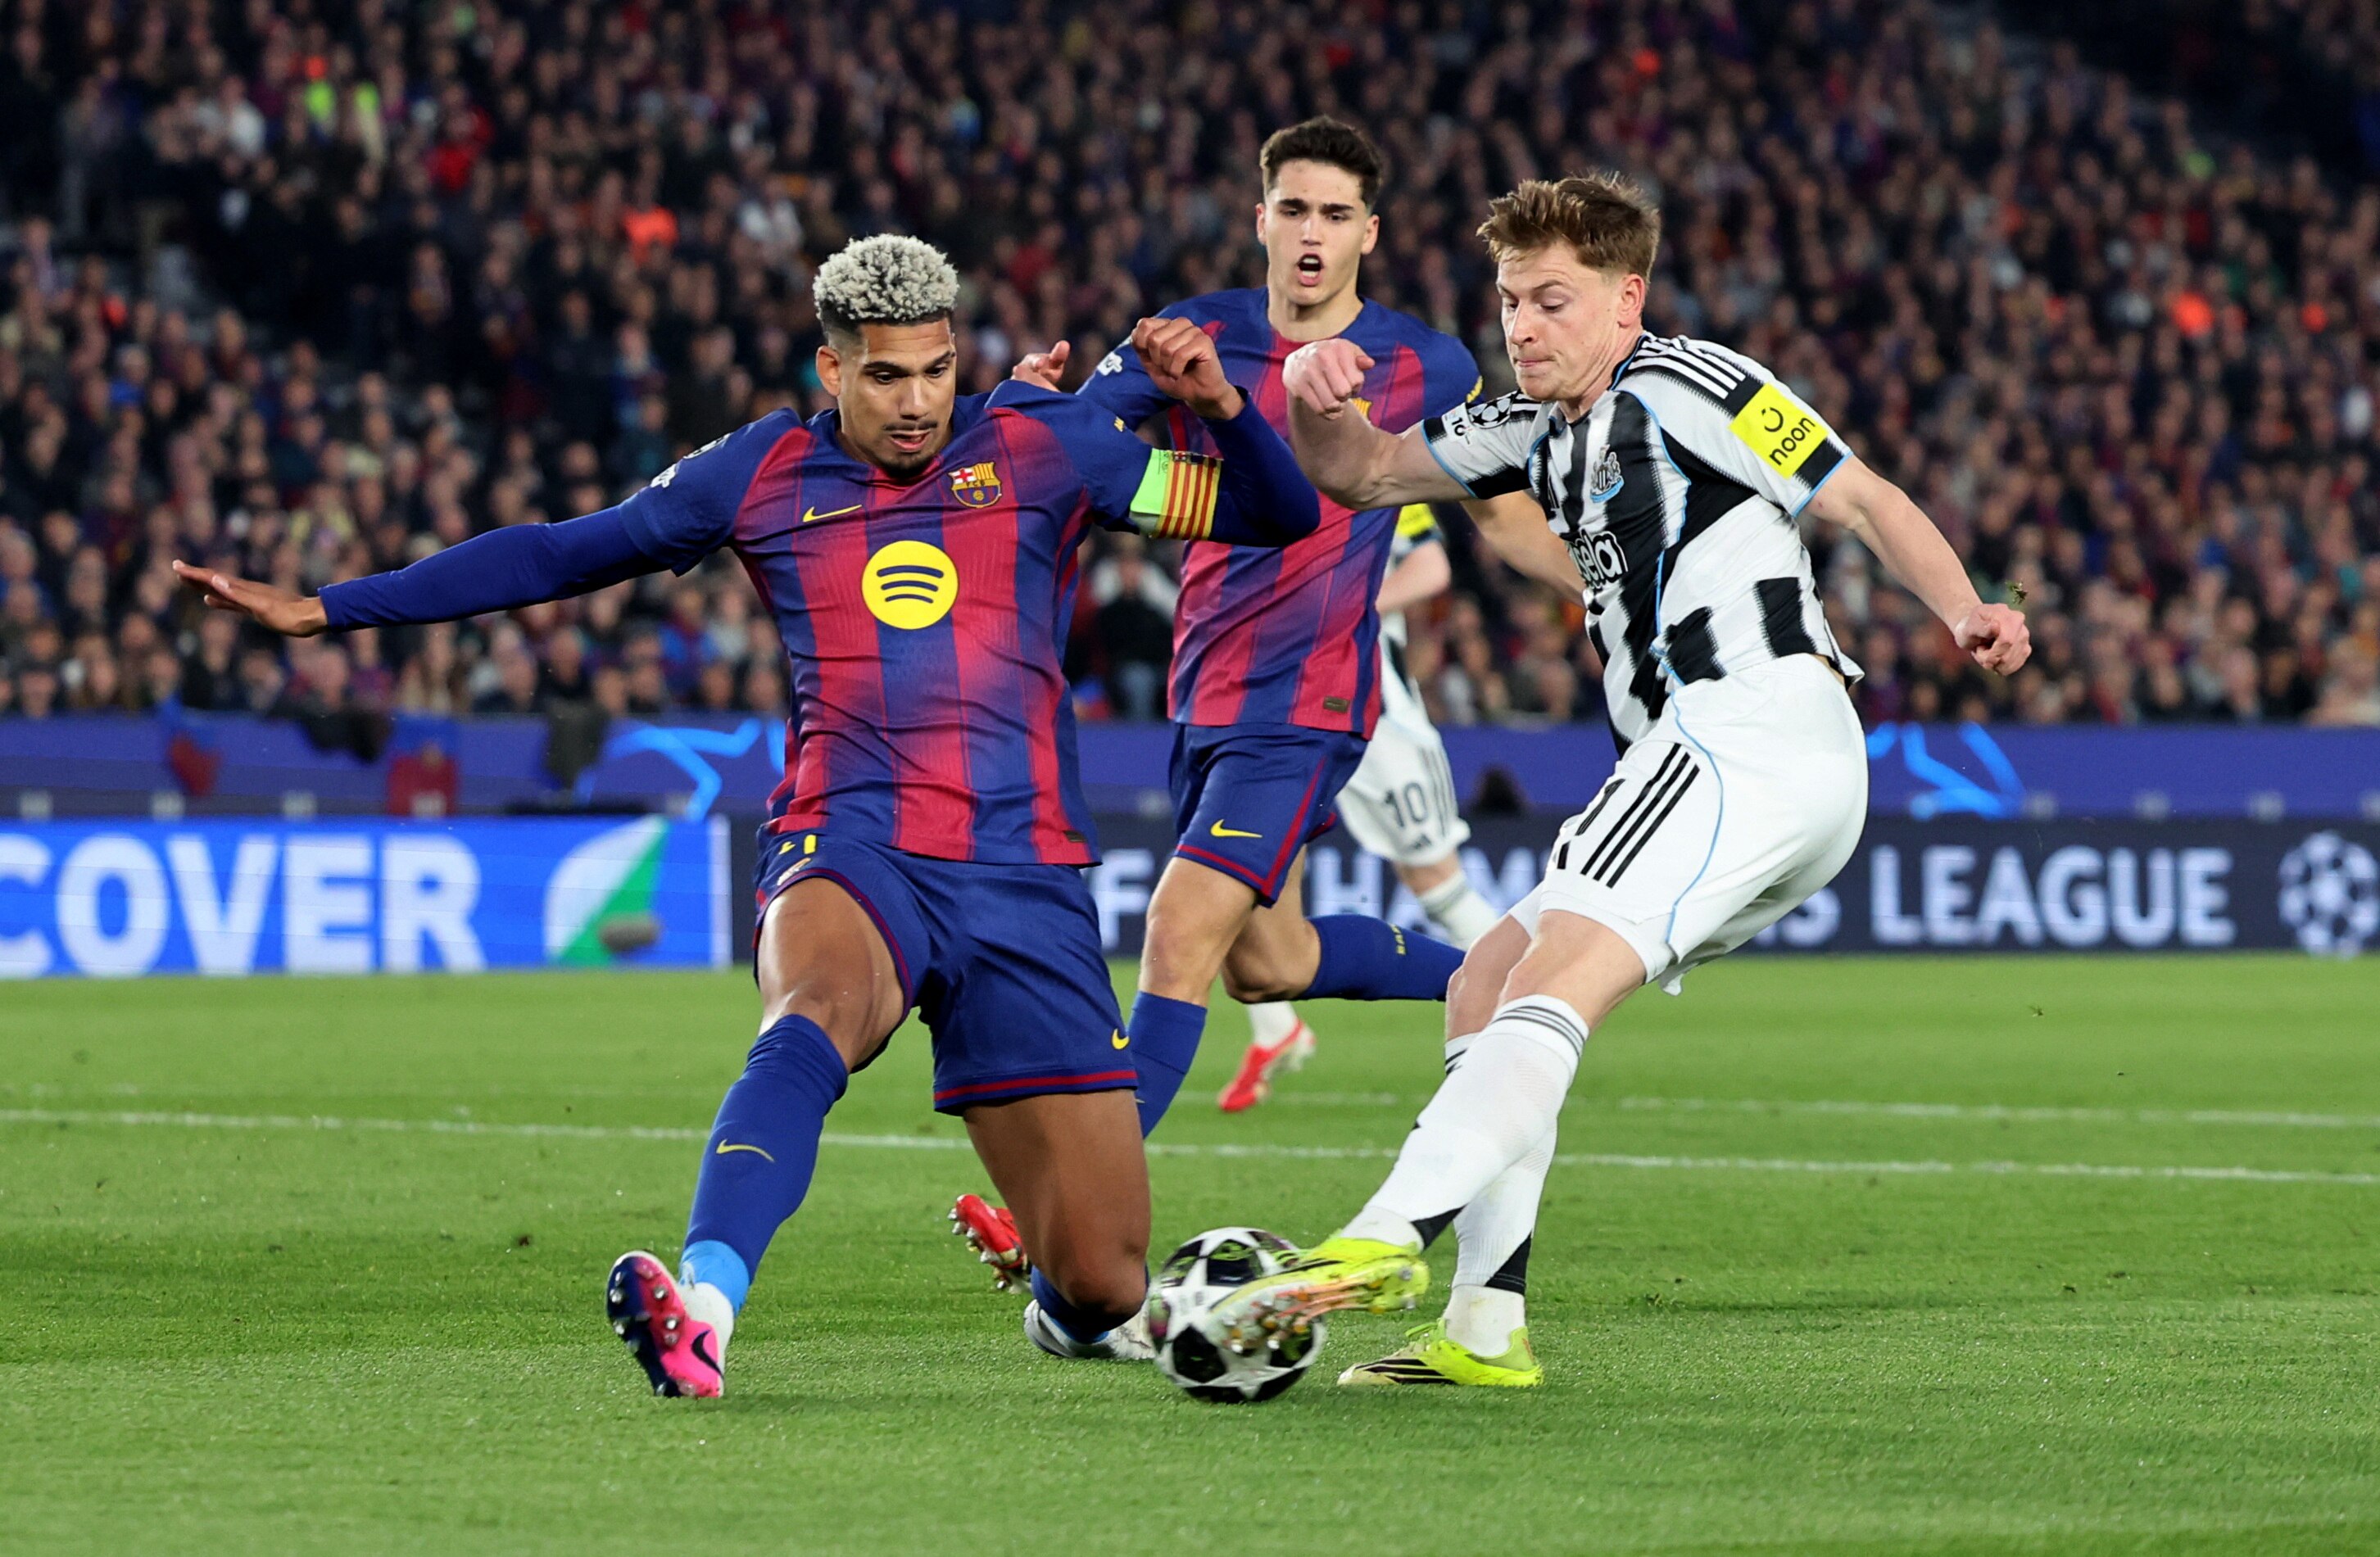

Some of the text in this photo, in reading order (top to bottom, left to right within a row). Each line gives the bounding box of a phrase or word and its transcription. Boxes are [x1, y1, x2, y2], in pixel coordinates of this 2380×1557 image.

[1769, 417, 1816, 466] noon
[1385, 782, 1428, 827] 10
[1870, 846, 2237, 946] LEAGUE
